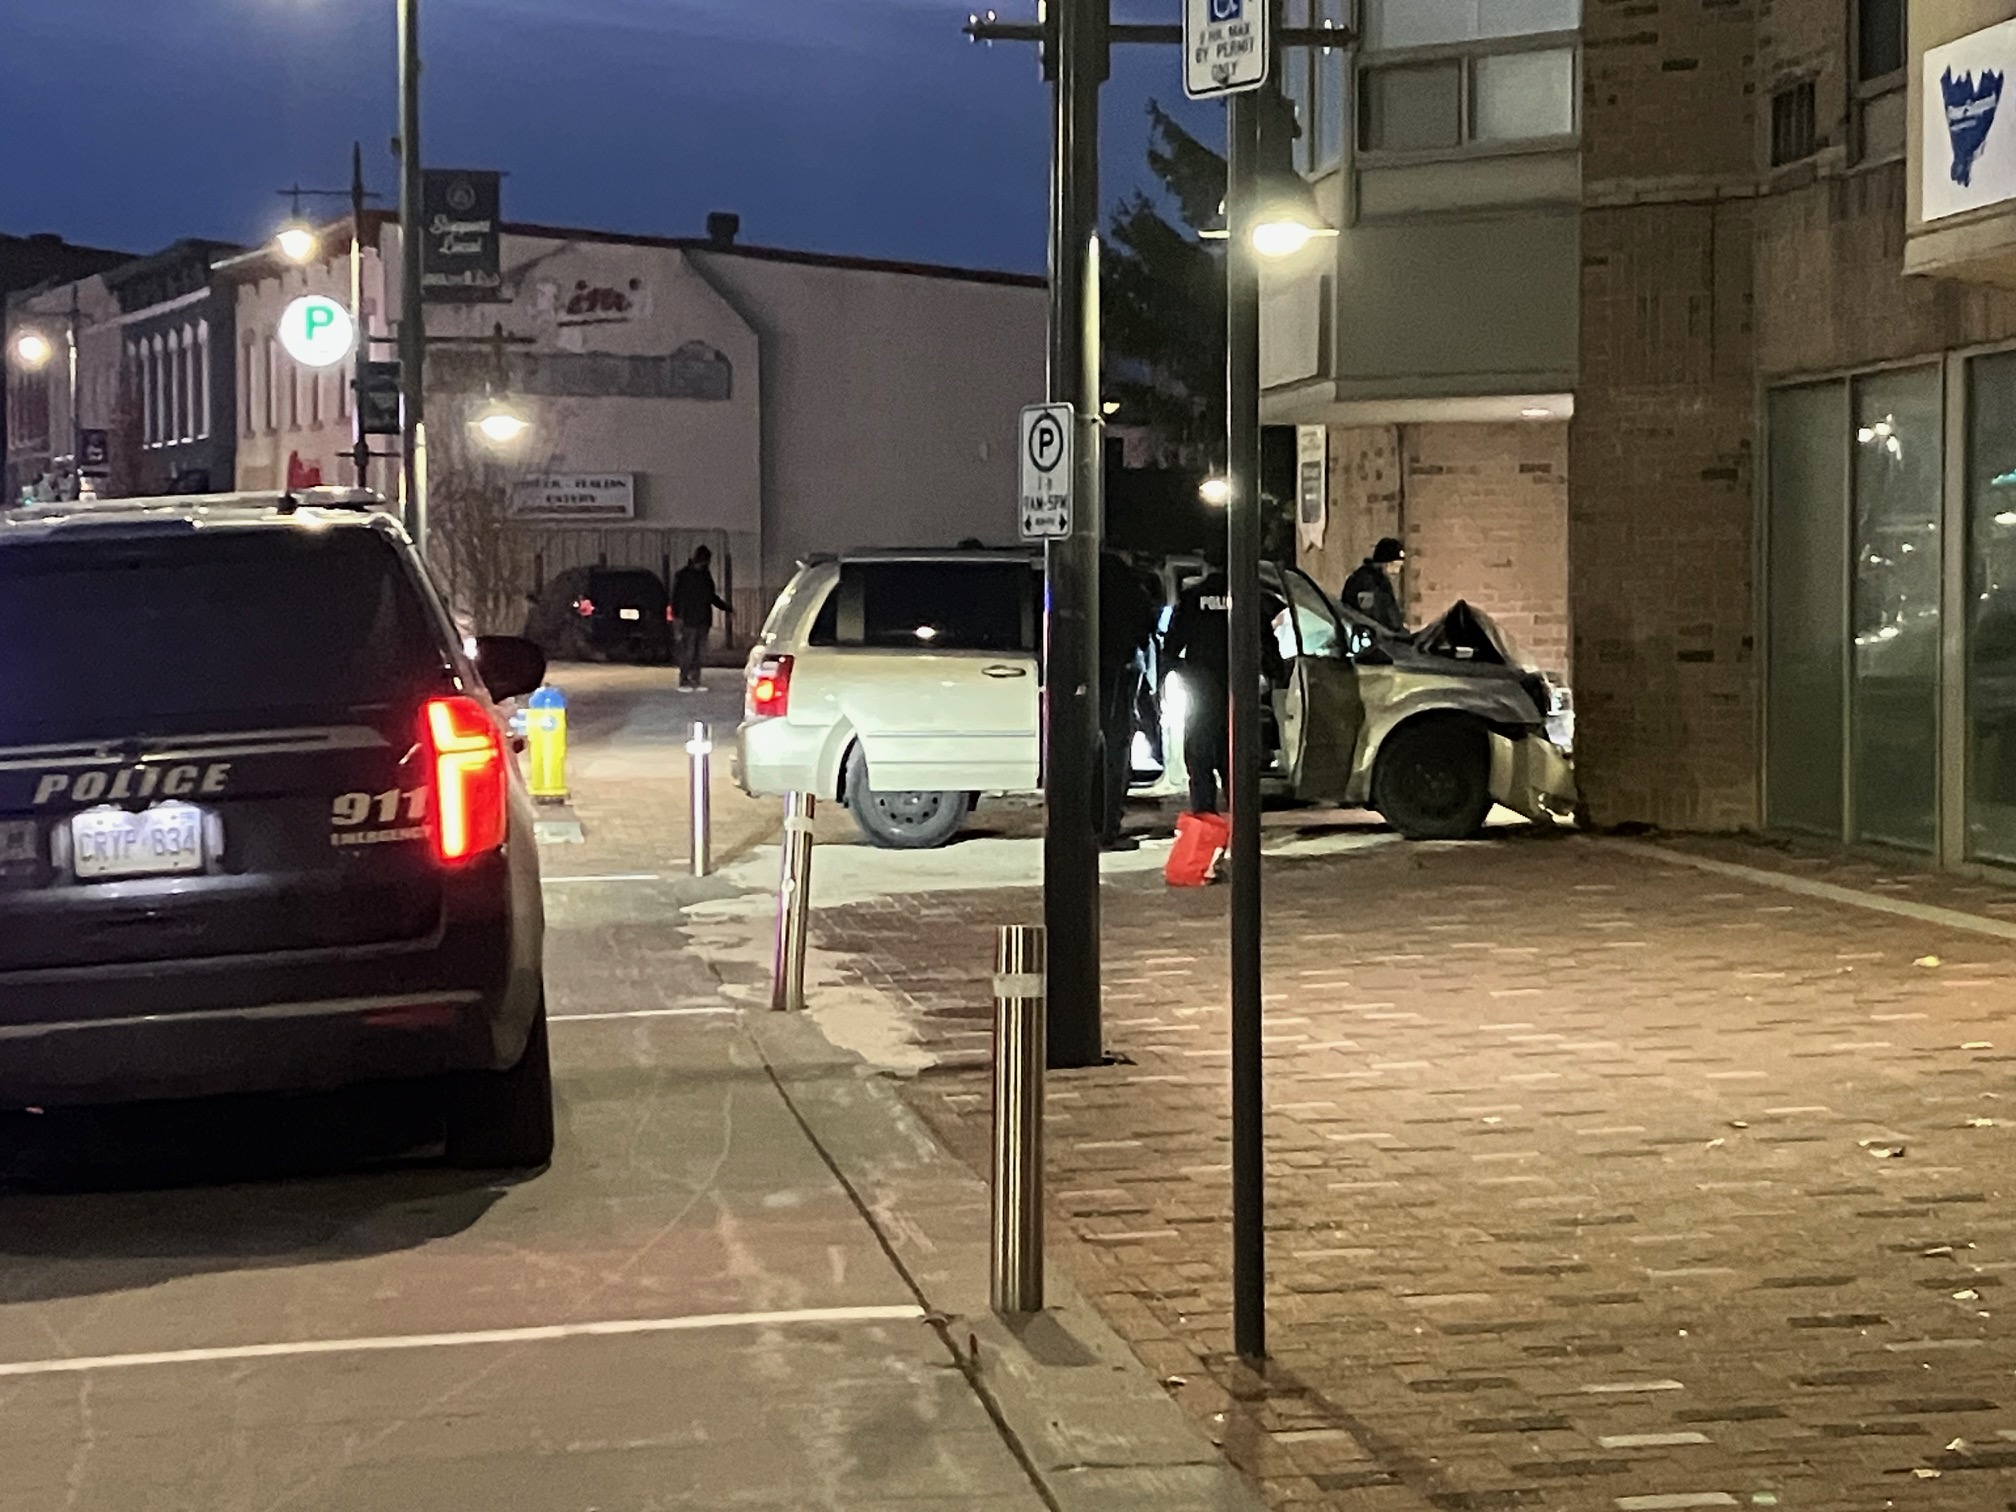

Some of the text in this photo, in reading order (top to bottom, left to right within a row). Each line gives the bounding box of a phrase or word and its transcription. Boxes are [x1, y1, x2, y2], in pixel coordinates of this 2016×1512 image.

[305, 306, 335, 341] P
[1039, 427, 1055, 459] P
[1200, 595, 1230, 610] POLI
[32, 763, 232, 804] POLICE
[331, 785, 431, 825] 911
[151, 824, 197, 857] 834
